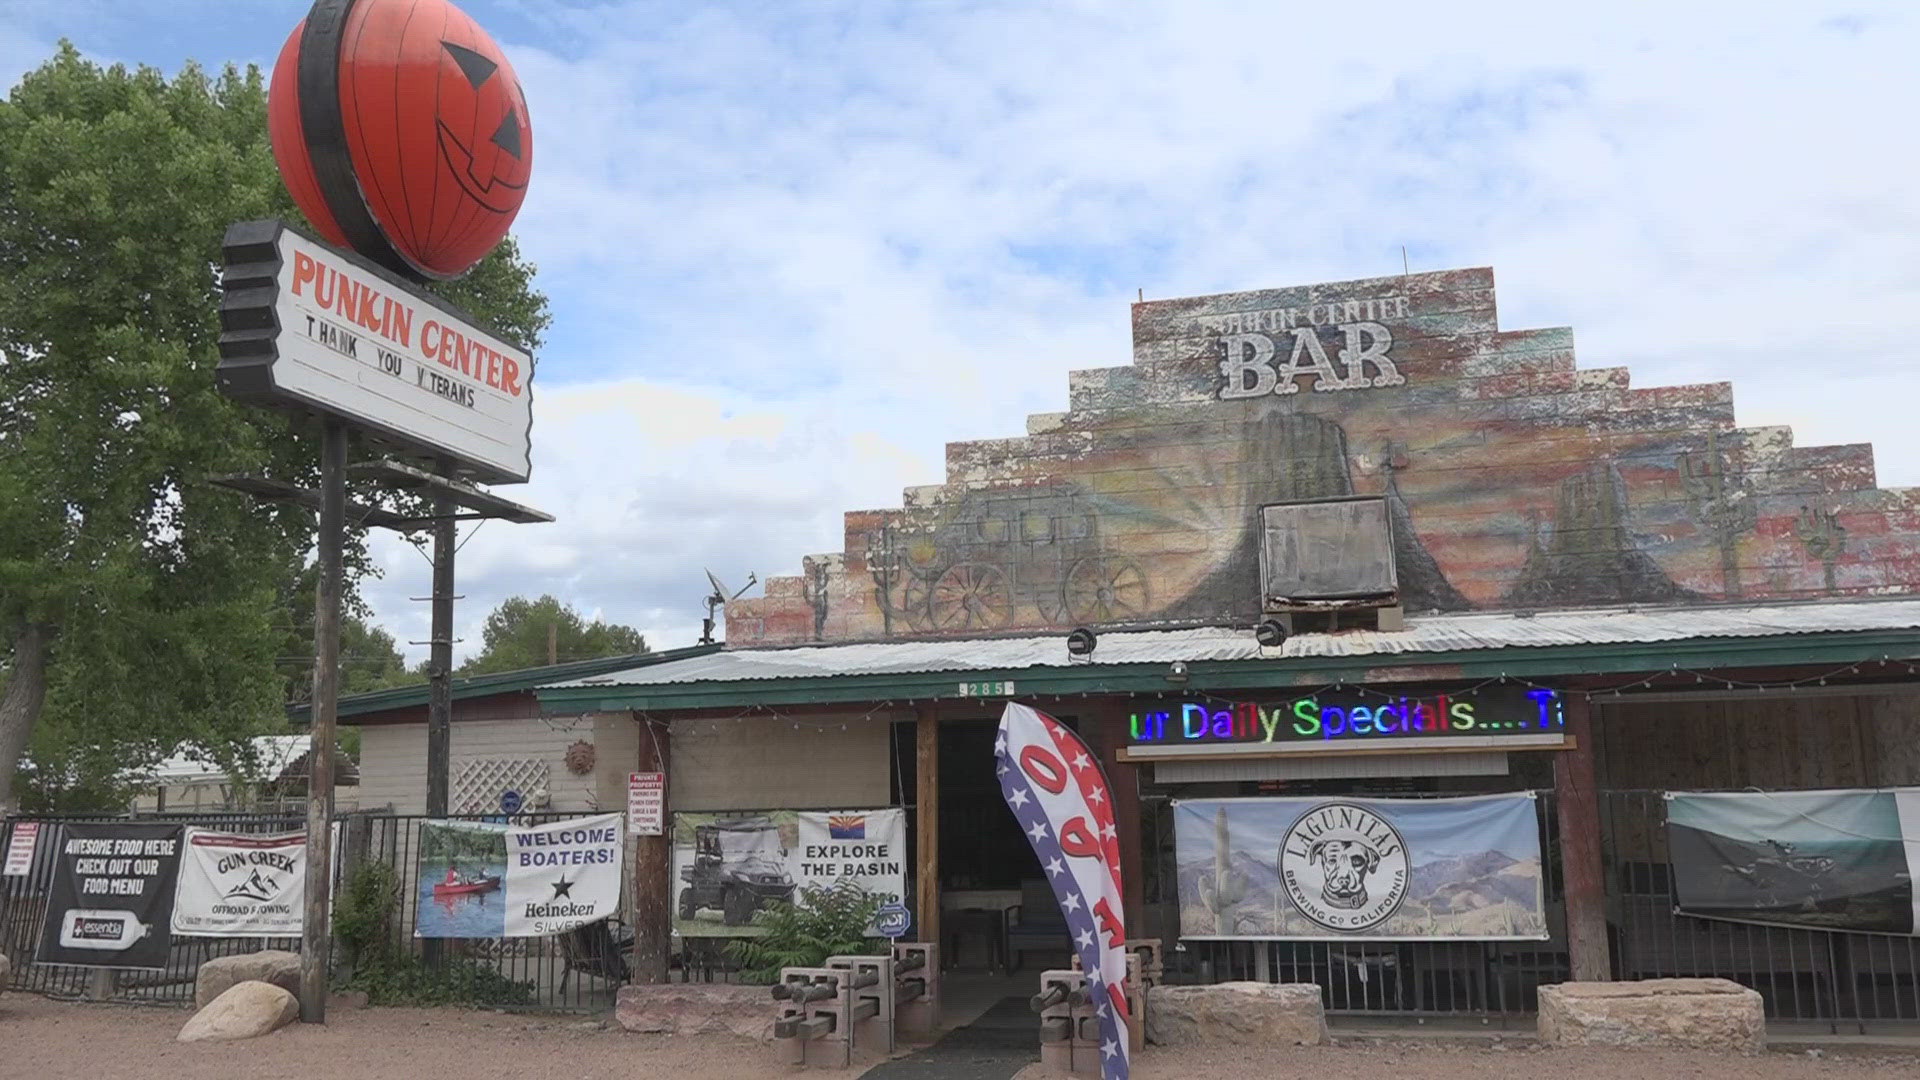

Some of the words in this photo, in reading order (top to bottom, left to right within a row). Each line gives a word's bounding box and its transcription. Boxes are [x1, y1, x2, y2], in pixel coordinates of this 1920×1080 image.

[1309, 297, 1414, 326] CENTER
[291, 249, 414, 349] PUNKIN
[420, 319, 522, 397] CENTER
[305, 315, 358, 358] THANK
[376, 348, 402, 377] YOU
[1219, 321, 1406, 399] BAR
[969, 682, 1003, 696] 285
[1130, 712, 1169, 740] ur
[1182, 703, 1281, 743] Daily
[516, 828, 615, 847] WELCOME
[1286, 808, 1401, 859] LAGUNITAS
[65, 838, 114, 856] AWESOME
[114, 839, 144, 856] FOOD
[144, 839, 177, 856] HERE
[806, 844, 889, 858] EXPLORE
[75, 858, 108, 874] CHECK
[108, 859, 132, 875] OUT
[133, 859, 159, 875] OUR
[218, 852, 246, 874] GUN
[249, 851, 297, 875] CREEK
[520, 849, 615, 867] BOATERS!
[801, 863, 836, 876] THE
[843, 862, 899, 876] BASIN
[83, 878, 109, 894] FOOD
[110, 878, 145, 895] MENU
[1285, 870, 1325, 920] BREWING
[1351, 869, 1404, 925] CALIFORNIA
[212, 904, 249, 915] OFFROAD
[525, 902, 595, 918] Heineken
[84, 921, 121, 934] essentia
